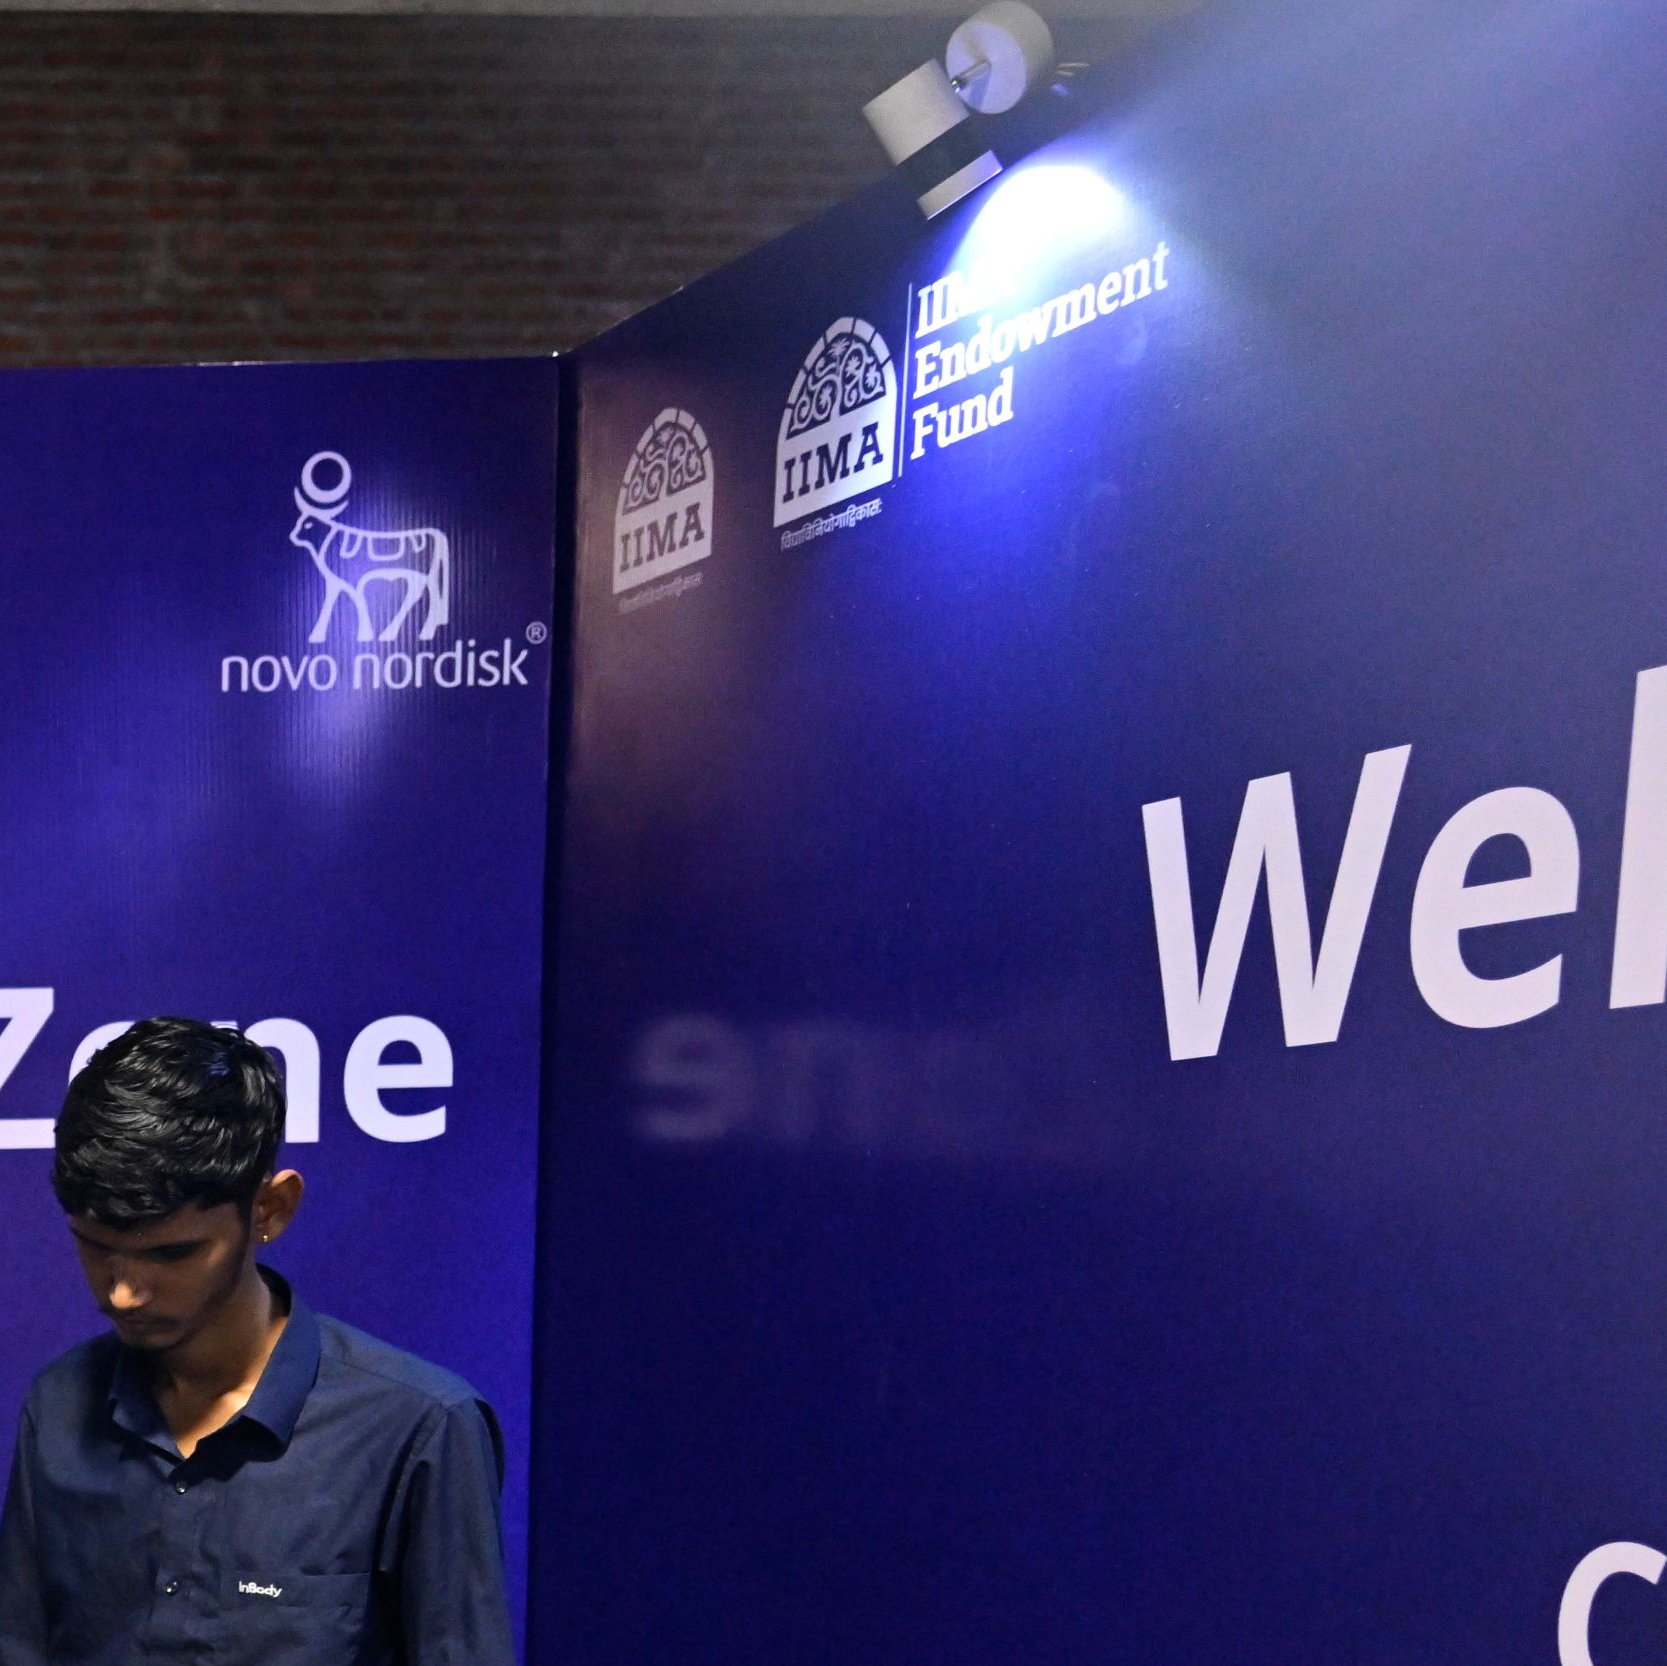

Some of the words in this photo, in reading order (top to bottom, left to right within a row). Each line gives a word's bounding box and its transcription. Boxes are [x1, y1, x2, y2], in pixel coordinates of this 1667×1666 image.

[913, 241, 1170, 400] Endowment
[910, 366, 1014, 460] Fund
[783, 422, 884, 503] IIMA
[620, 502, 705, 573] IIMA
[221, 654, 338, 693] novo
[239, 1580, 283, 1598] InBody
